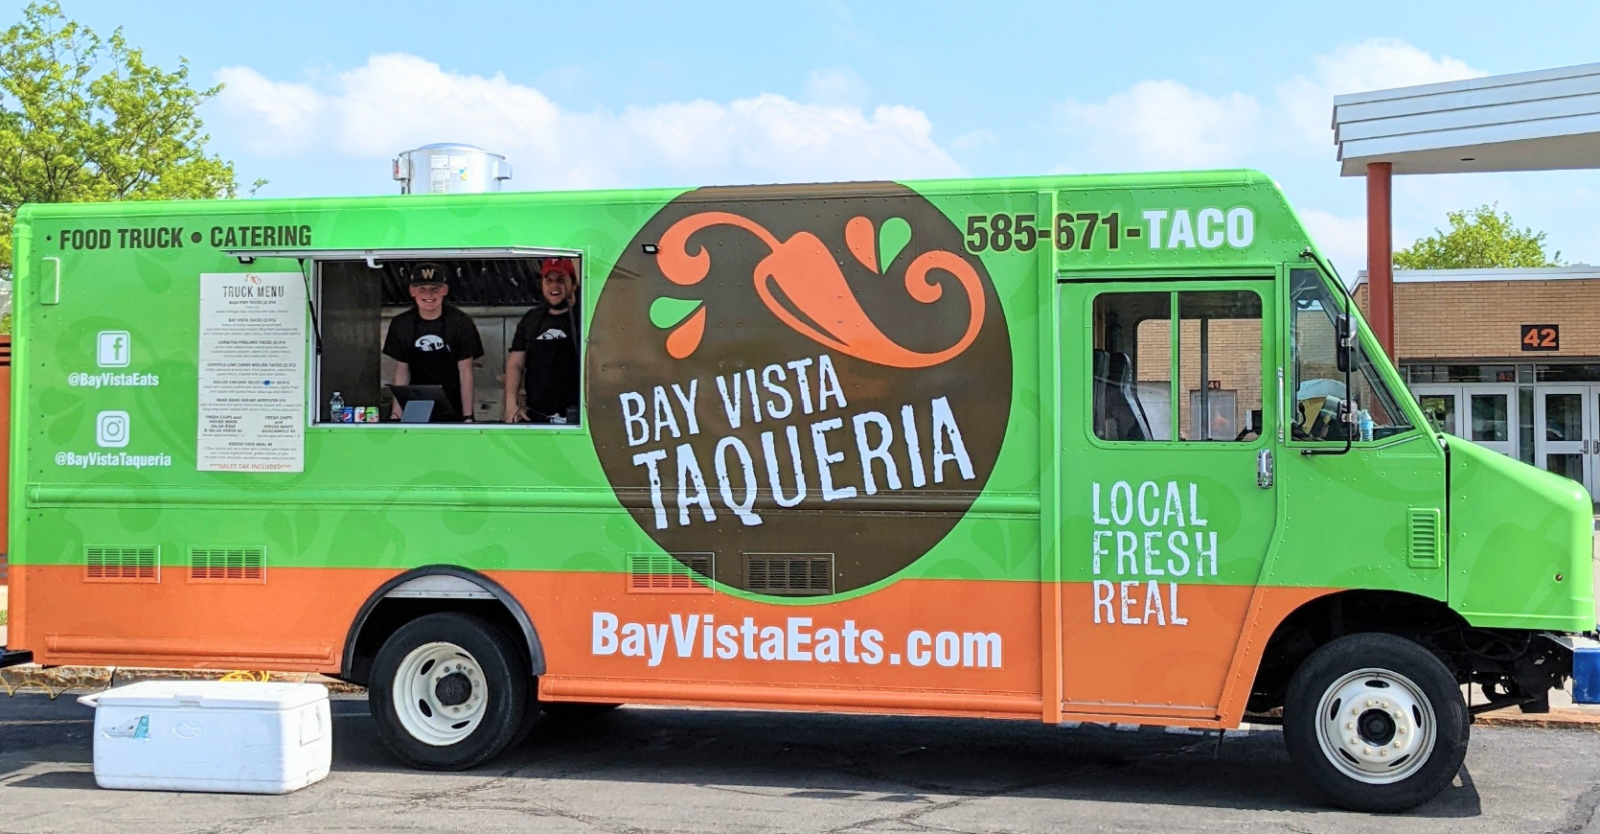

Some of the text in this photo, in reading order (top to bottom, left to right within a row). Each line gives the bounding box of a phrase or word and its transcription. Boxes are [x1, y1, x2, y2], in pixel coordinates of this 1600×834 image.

[60, 225, 312, 250] FOOD TRUCK CATERING
[966, 207, 1254, 251] 585-671-TACO
[222, 285, 285, 298] TRUCK MENU
[421, 268, 435, 279] W
[1523, 328, 1557, 347] 42
[68, 372, 159, 389] @BayVistaEats
[620, 354, 847, 446] BAY VISTA
[55, 452, 172, 469] @BayVistaTaqueria
[633, 396, 975, 530] TAQUERIA
[1092, 480, 1208, 527] LOCAL
[1093, 531, 1218, 577] FRESH
[1093, 580, 1189, 626] REAL
[592, 612, 1002, 667] BayVistaEats.com
